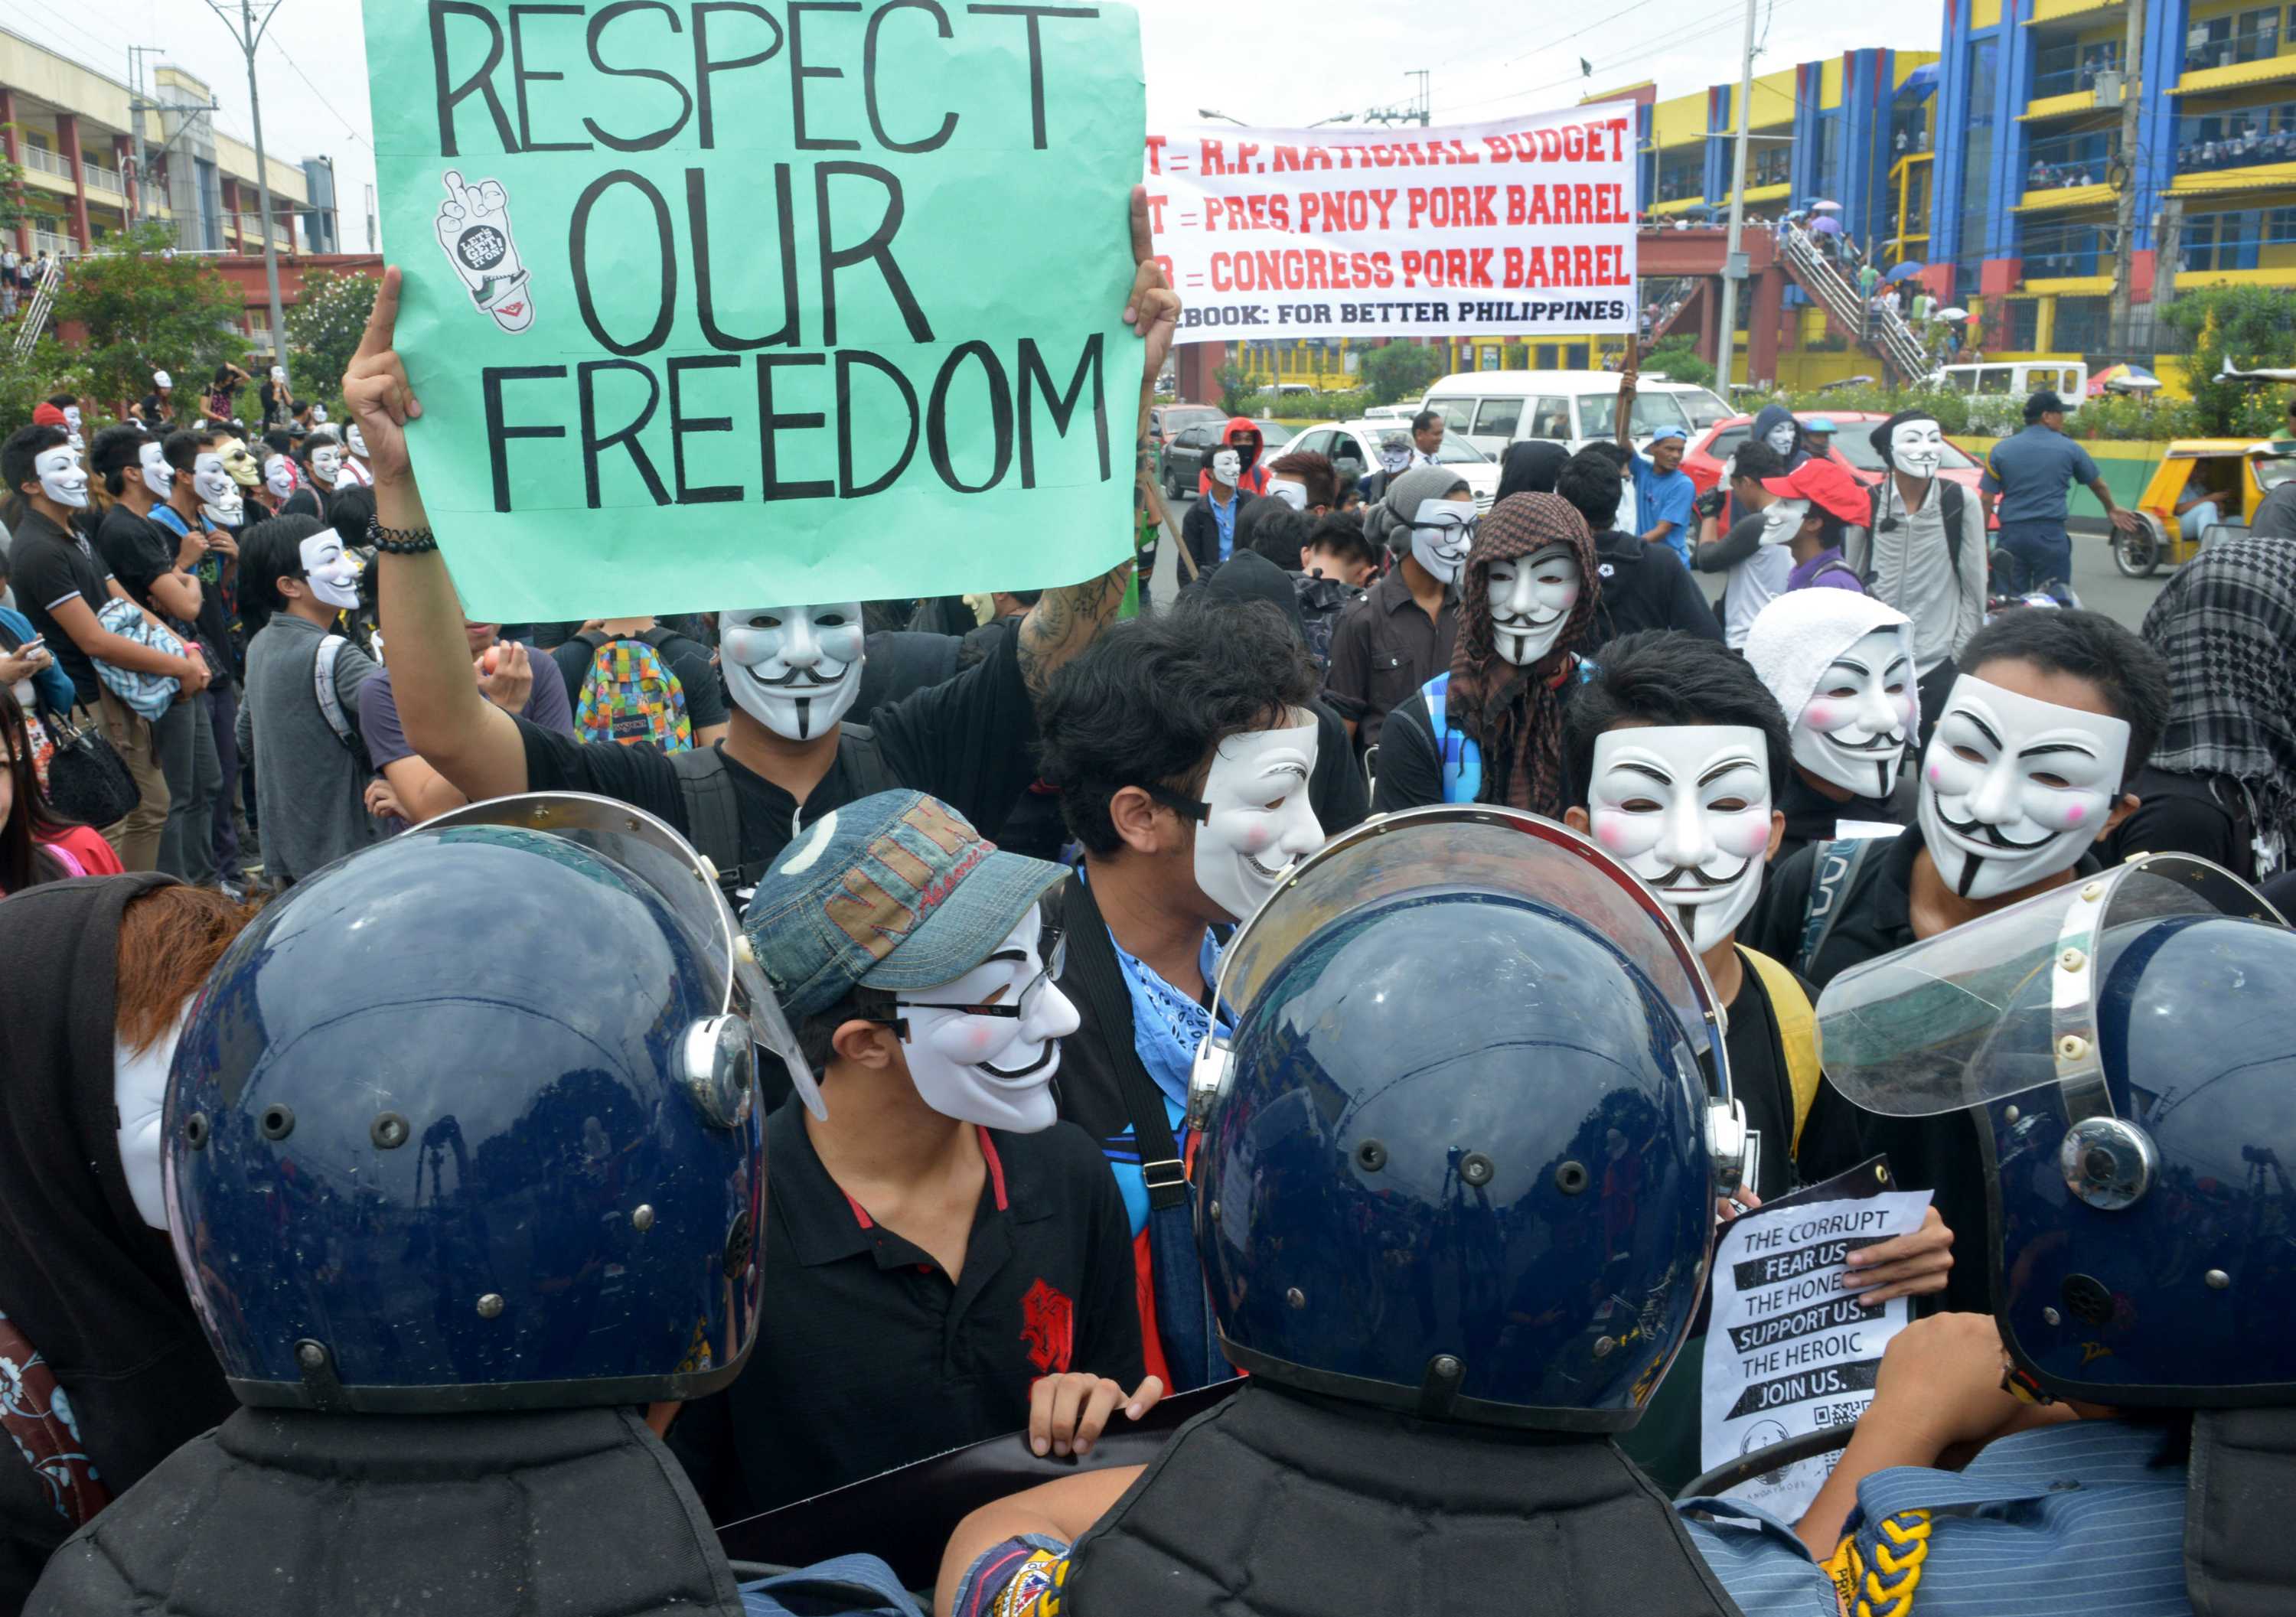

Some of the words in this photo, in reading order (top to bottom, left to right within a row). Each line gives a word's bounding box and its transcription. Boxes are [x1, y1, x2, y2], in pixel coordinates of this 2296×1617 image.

[429, 0, 1099, 158] RESPECT
[1483, 119, 1629, 164] BUDGET
[1407, 186, 1499, 230] PORK
[1507, 184, 1630, 226] BARREL
[569, 161, 935, 357] OUR
[1211, 249, 1394, 292] CONGRESS
[1401, 248, 1497, 289] PORK
[1504, 246, 1632, 289] BARREL
[1278, 305, 1332, 324] FOR
[1341, 302, 1450, 323] BETTER
[1458, 301, 1631, 322] PHILIPPINES)
[483, 332, 1112, 513] FREEDOM
[1745, 1227, 1783, 1253] THE
[1789, 1211, 1890, 1243] CORRUPT
[1766, 1250, 1815, 1280] FEAR
[1739, 1306, 1831, 1350] SUPPORT
[1833, 1300, 1867, 1322] US.
[1745, 1290, 1784, 1315] THE
[1743, 1351, 1780, 1377] THE
[1786, 1332, 1863, 1368] HEROIC
[1758, 1377, 1806, 1407] JOIN
[1811, 1370, 1848, 1394] US.
